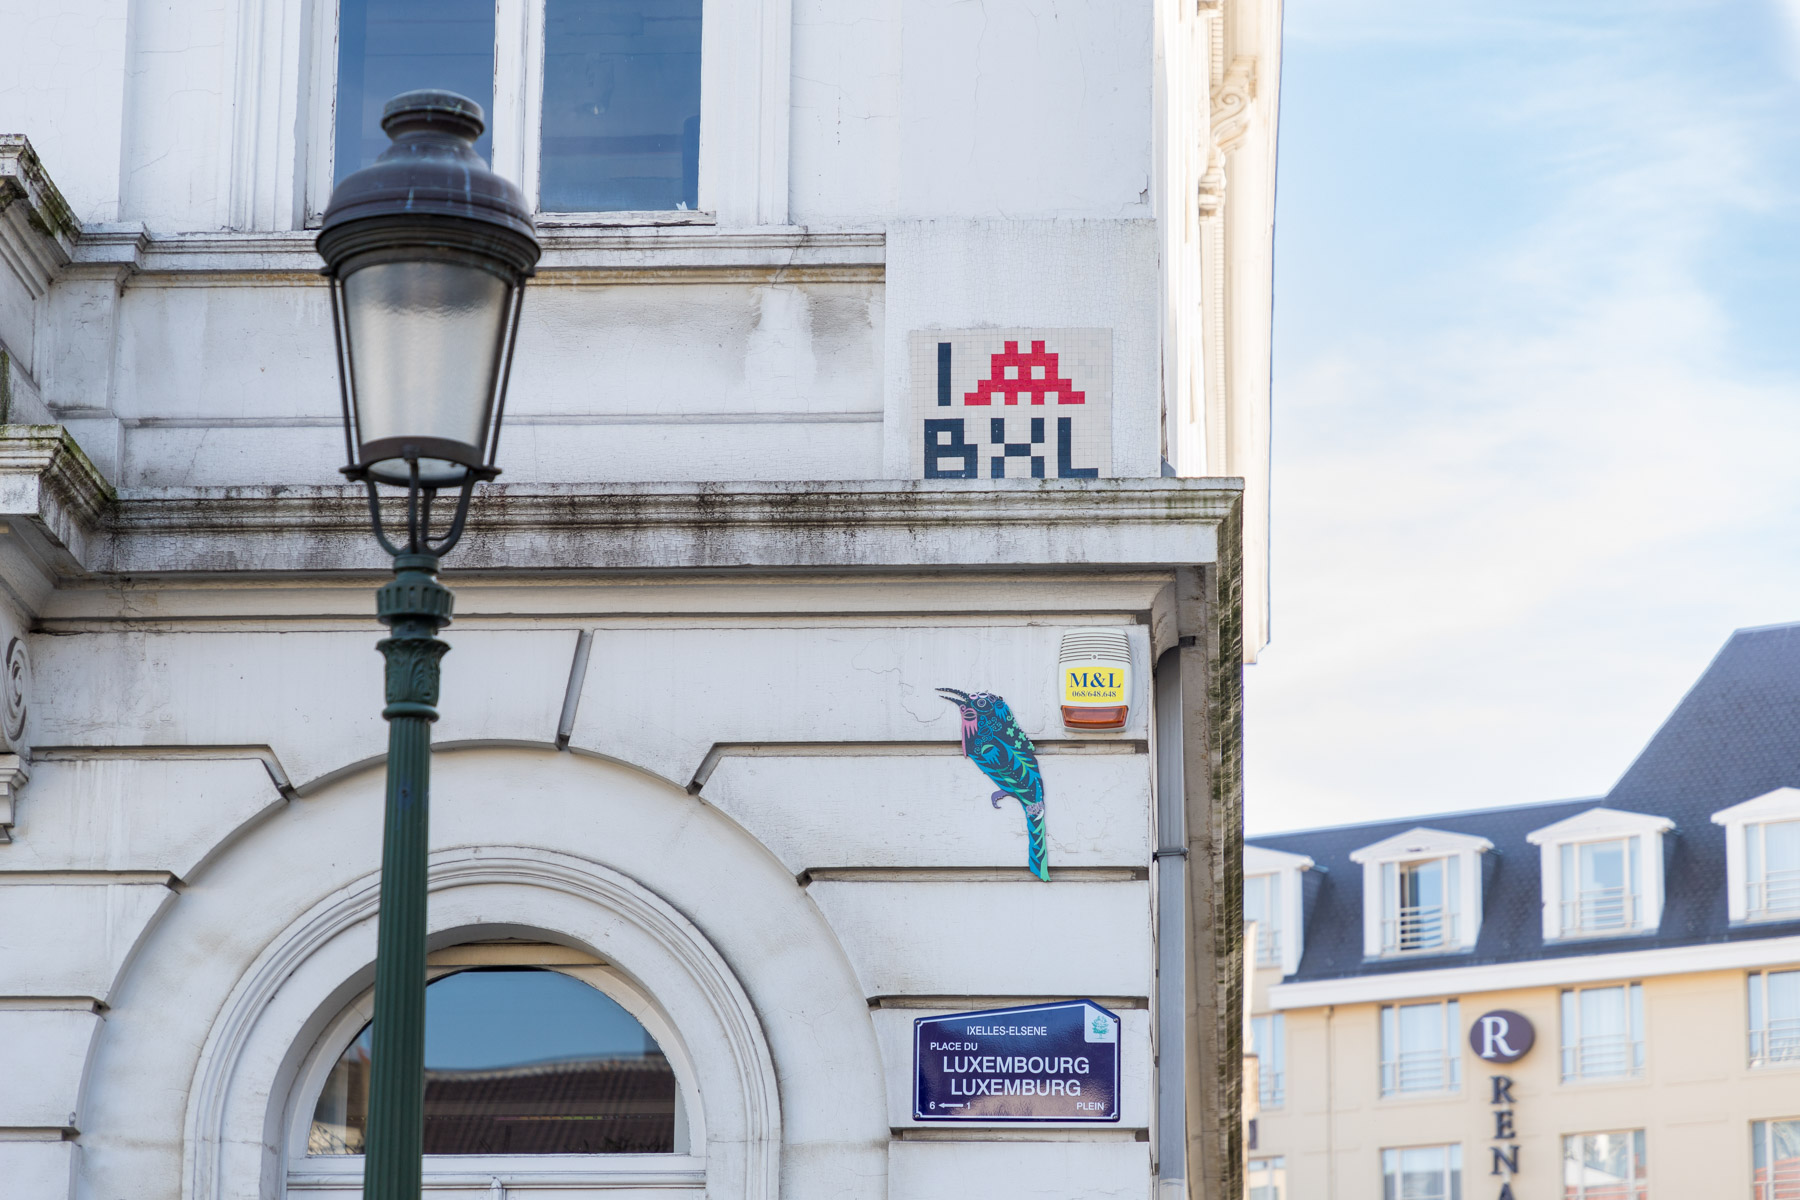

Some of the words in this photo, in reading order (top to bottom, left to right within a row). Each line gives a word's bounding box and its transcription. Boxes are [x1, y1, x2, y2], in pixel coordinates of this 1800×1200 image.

[1069, 672, 1121, 688] M&L
[966, 1025, 1047, 1036] IXELLES-ELSENE
[1481, 1016, 1520, 1058] R
[930, 1042, 962, 1051] PLACE
[963, 1042, 978, 1051] DU
[943, 1056, 1090, 1074] LUXEMBOURG
[951, 1079, 1081, 1096] LUXEMBURG
[929, 1101, 936, 1110] 6
[966, 1101, 971, 1110] 1
[1076, 1102, 1105, 1111] PLEIN
